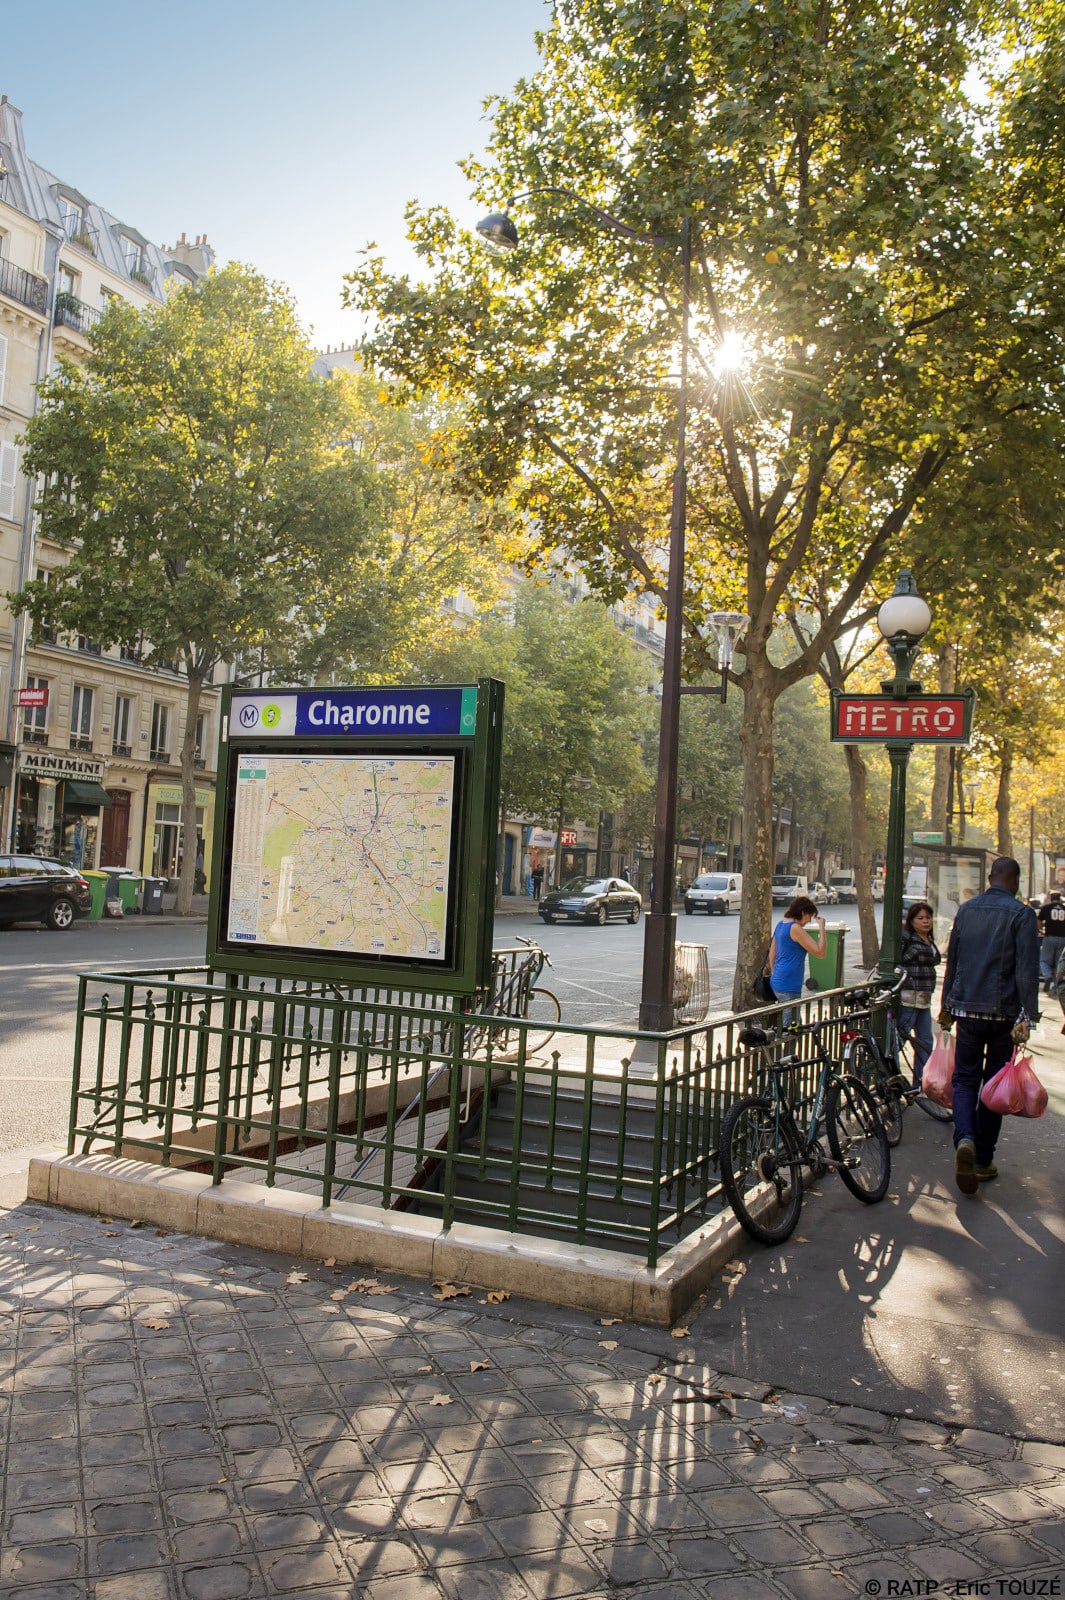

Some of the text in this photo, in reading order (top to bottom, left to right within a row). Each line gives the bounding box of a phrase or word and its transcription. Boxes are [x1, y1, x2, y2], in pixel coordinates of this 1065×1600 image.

[308, 699, 430, 726] Charonne
[845, 705, 956, 732] METRO
[1051, 908, 1065, 921] 08
